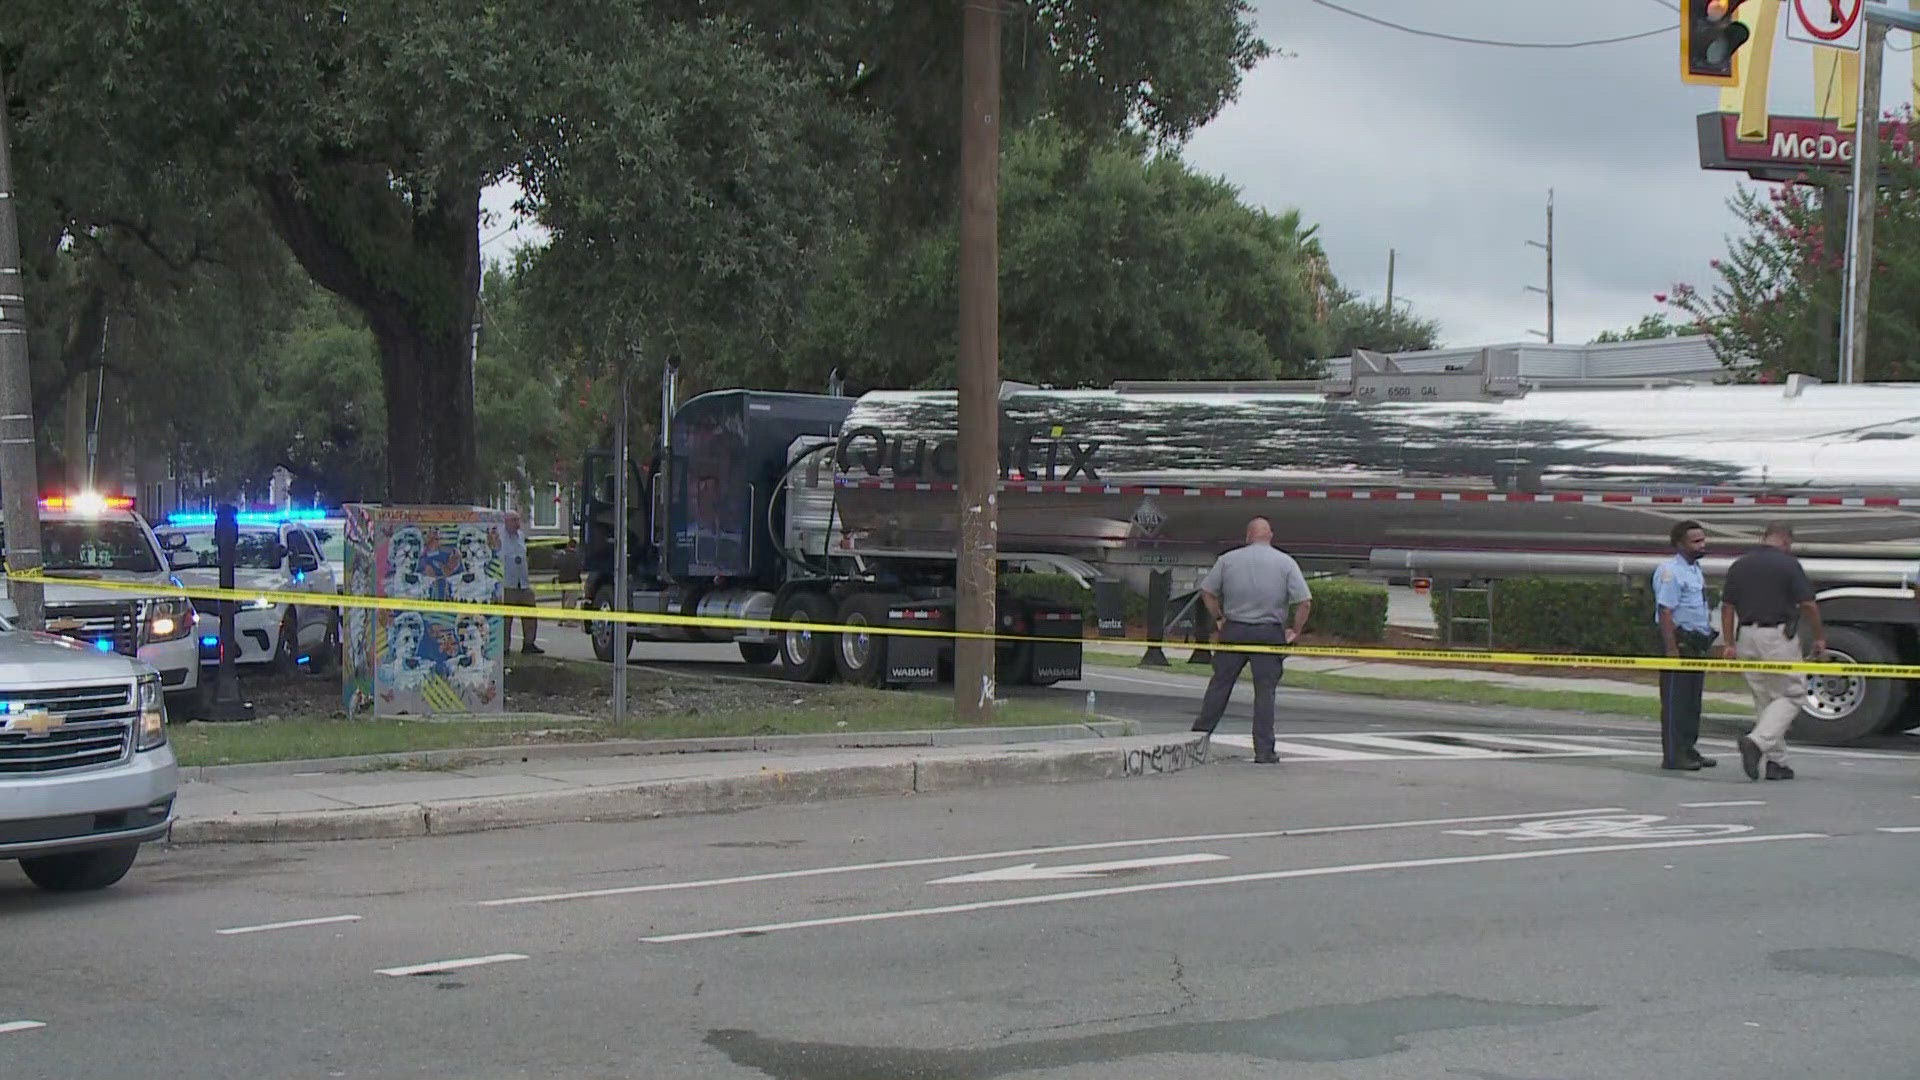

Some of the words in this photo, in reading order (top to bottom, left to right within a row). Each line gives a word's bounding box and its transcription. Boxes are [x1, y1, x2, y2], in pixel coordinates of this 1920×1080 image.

[1359, 387, 1376, 396] CAP
[1388, 387, 1411, 396] 6500
[1421, 387, 1438, 395] GAL
[892, 668, 934, 677] WABASH
[1038, 668, 1079, 677] WABASH
